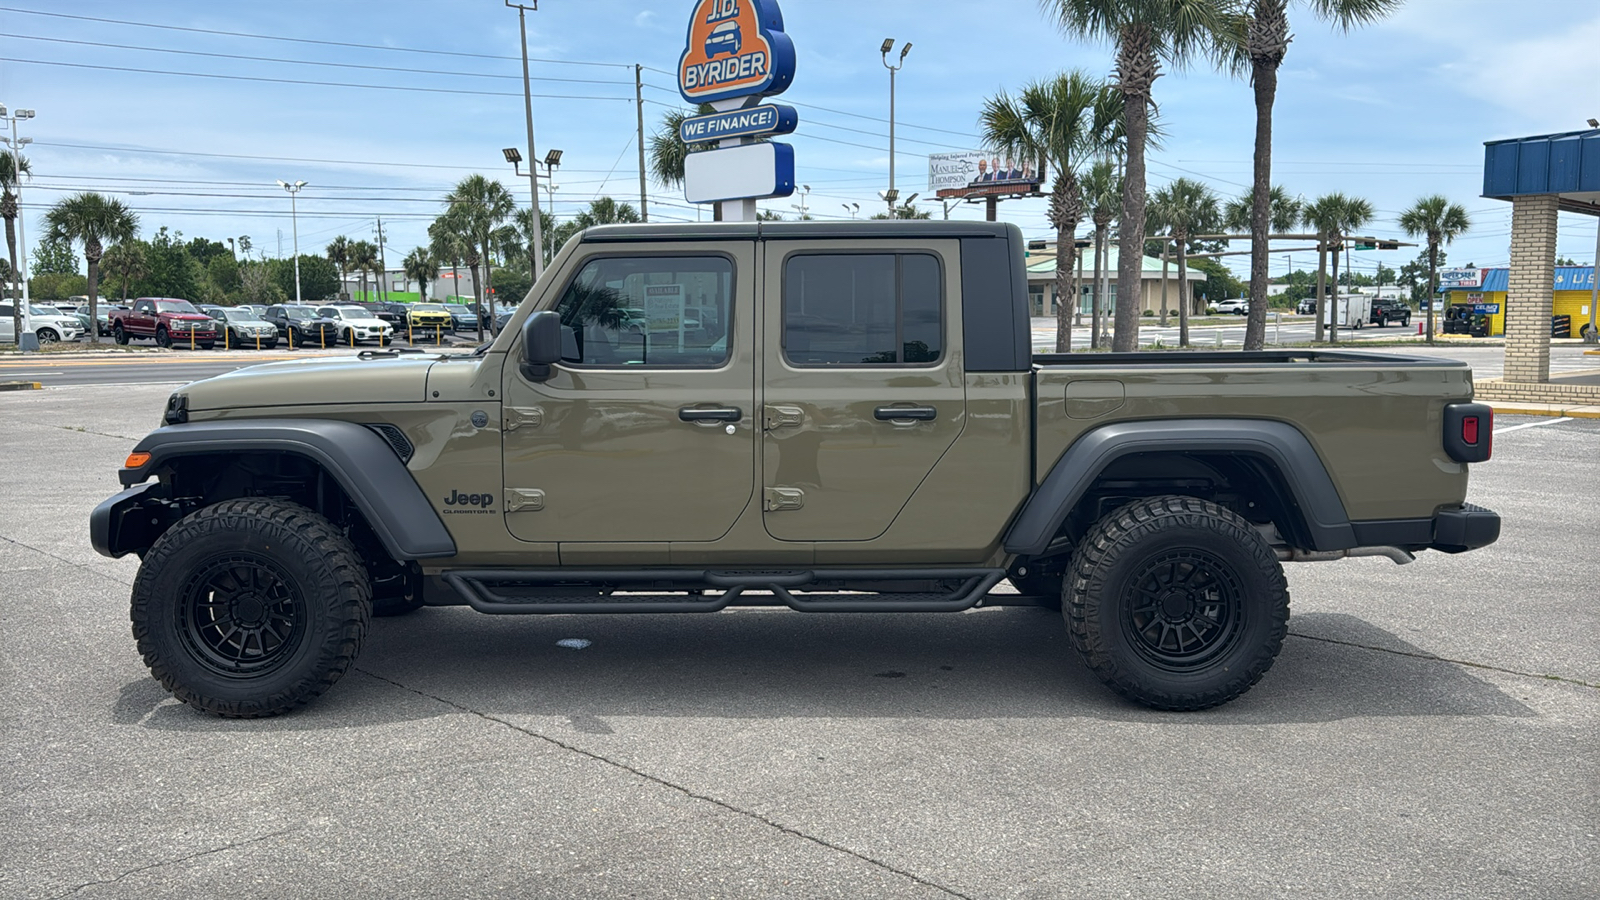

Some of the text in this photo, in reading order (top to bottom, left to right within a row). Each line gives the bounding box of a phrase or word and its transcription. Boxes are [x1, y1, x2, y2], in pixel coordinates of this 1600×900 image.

[708, 0, 739, 21] J.D.
[685, 53, 766, 88] BYRIDER
[685, 111, 772, 136] WE FINANCE!
[931, 164, 959, 174] MANUEL
[931, 174, 966, 184] THOMPSON
[1555, 275, 1564, 284] &
[443, 489, 494, 508] Jeep
